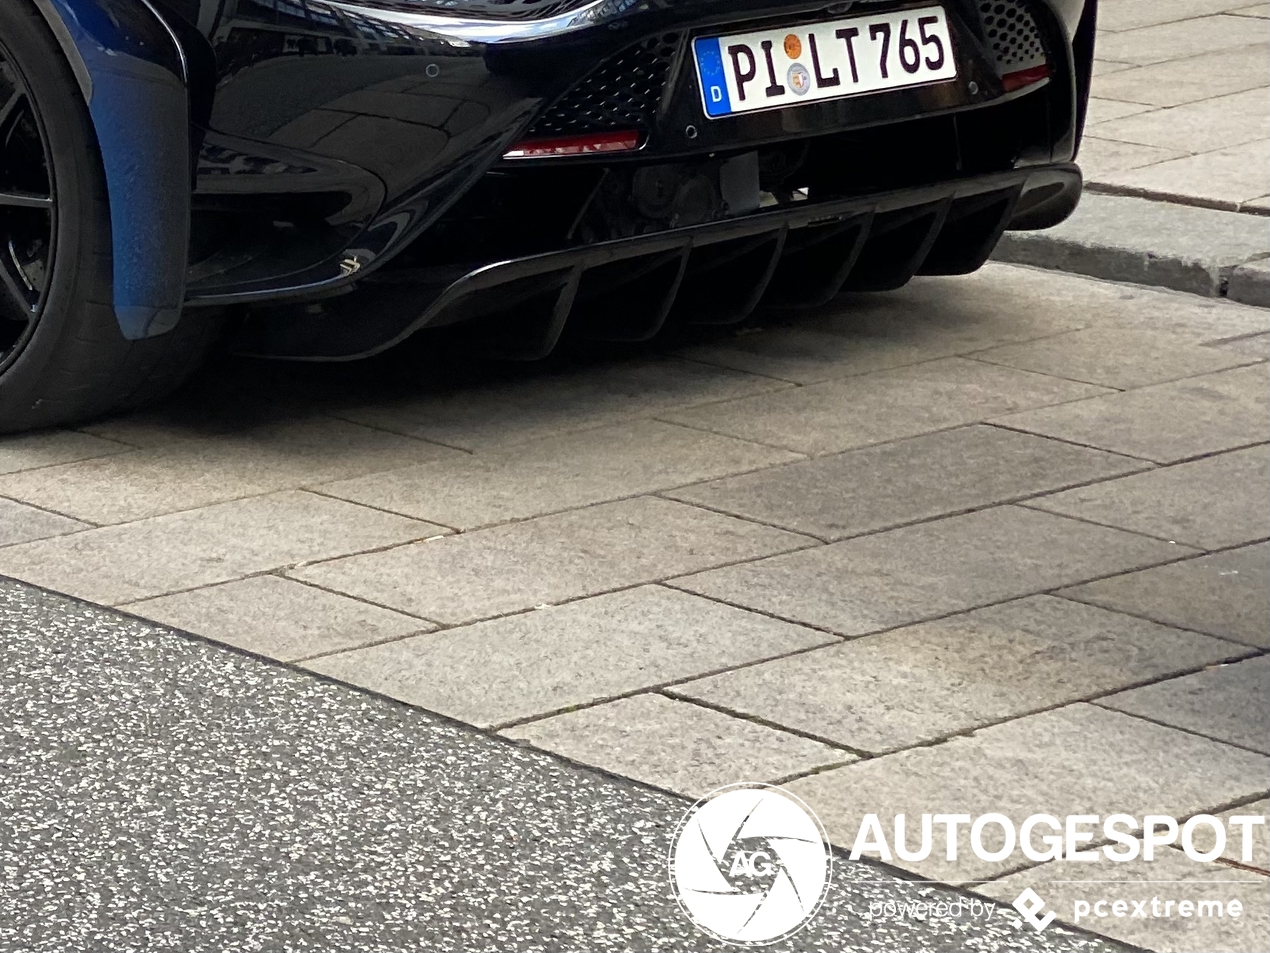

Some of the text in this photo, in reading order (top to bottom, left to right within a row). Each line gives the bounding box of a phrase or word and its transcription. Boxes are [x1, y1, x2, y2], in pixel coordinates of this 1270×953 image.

[727, 15, 945, 101] PI LT 765
[710, 85, 723, 102] D
